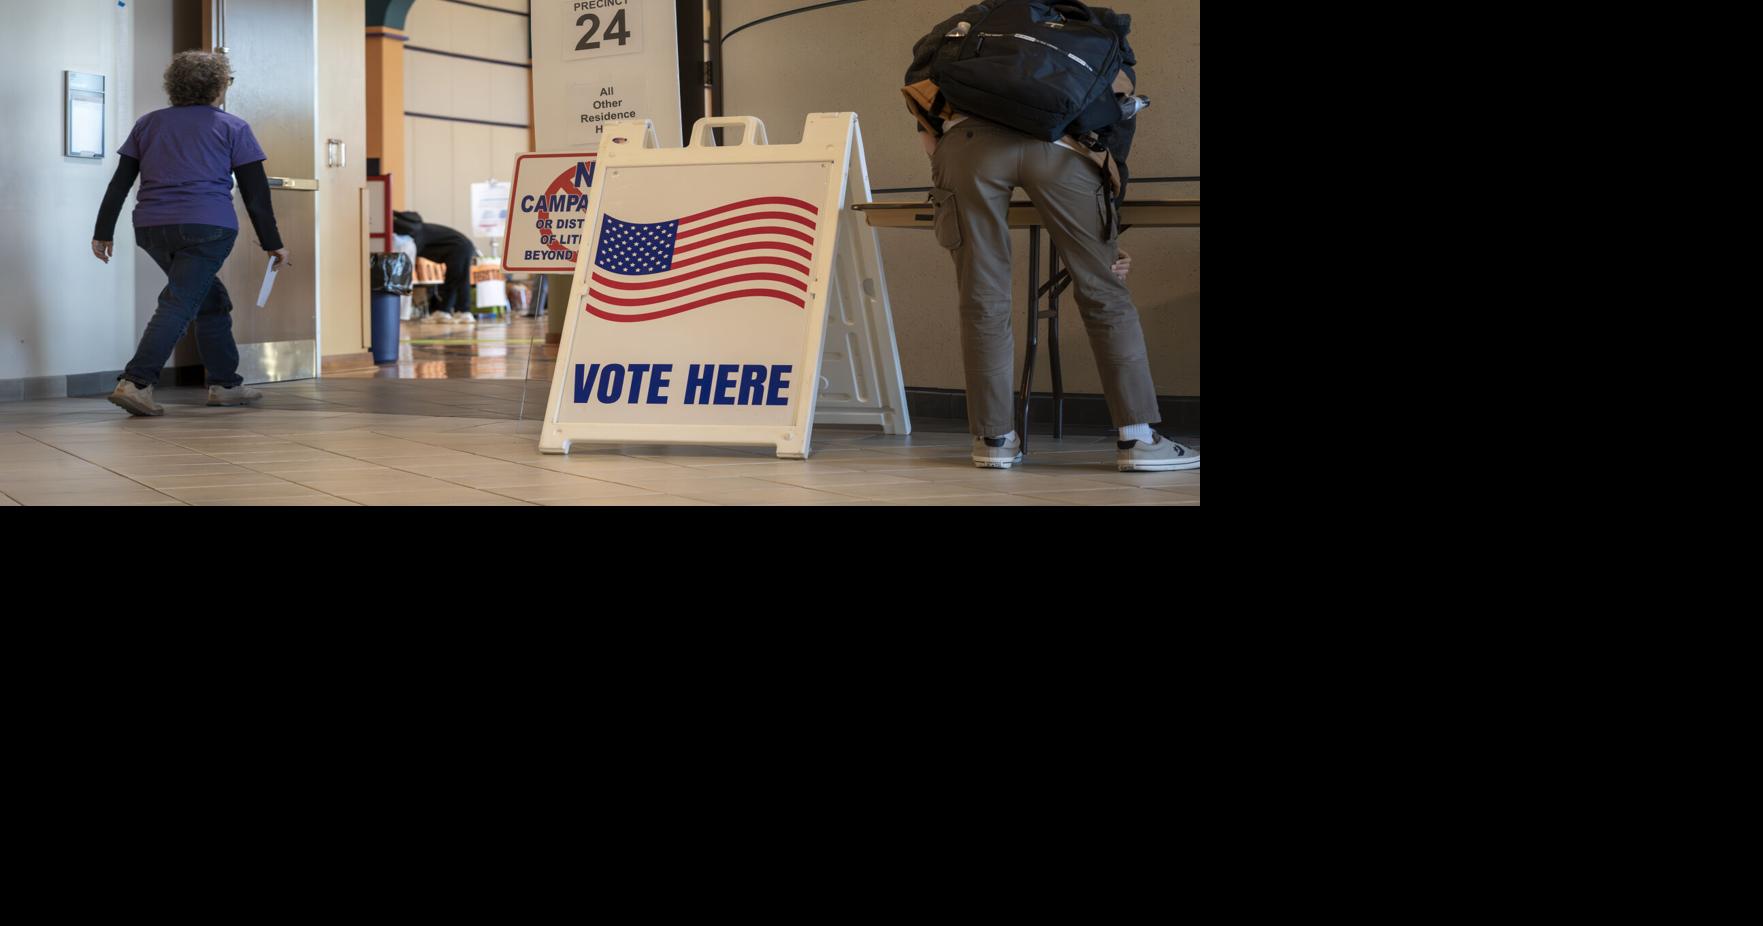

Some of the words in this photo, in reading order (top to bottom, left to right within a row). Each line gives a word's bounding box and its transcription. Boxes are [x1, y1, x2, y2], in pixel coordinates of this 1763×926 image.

[575, 8, 631, 51] 24
[600, 86, 614, 96] All
[592, 100, 622, 109] Other
[580, 111, 636, 123] Residence
[536, 219, 553, 229] OR
[540, 235, 557, 245] OF
[524, 250, 573, 260] BEYOND
[573, 363, 673, 404] VOTE
[683, 364, 793, 406] HERE
